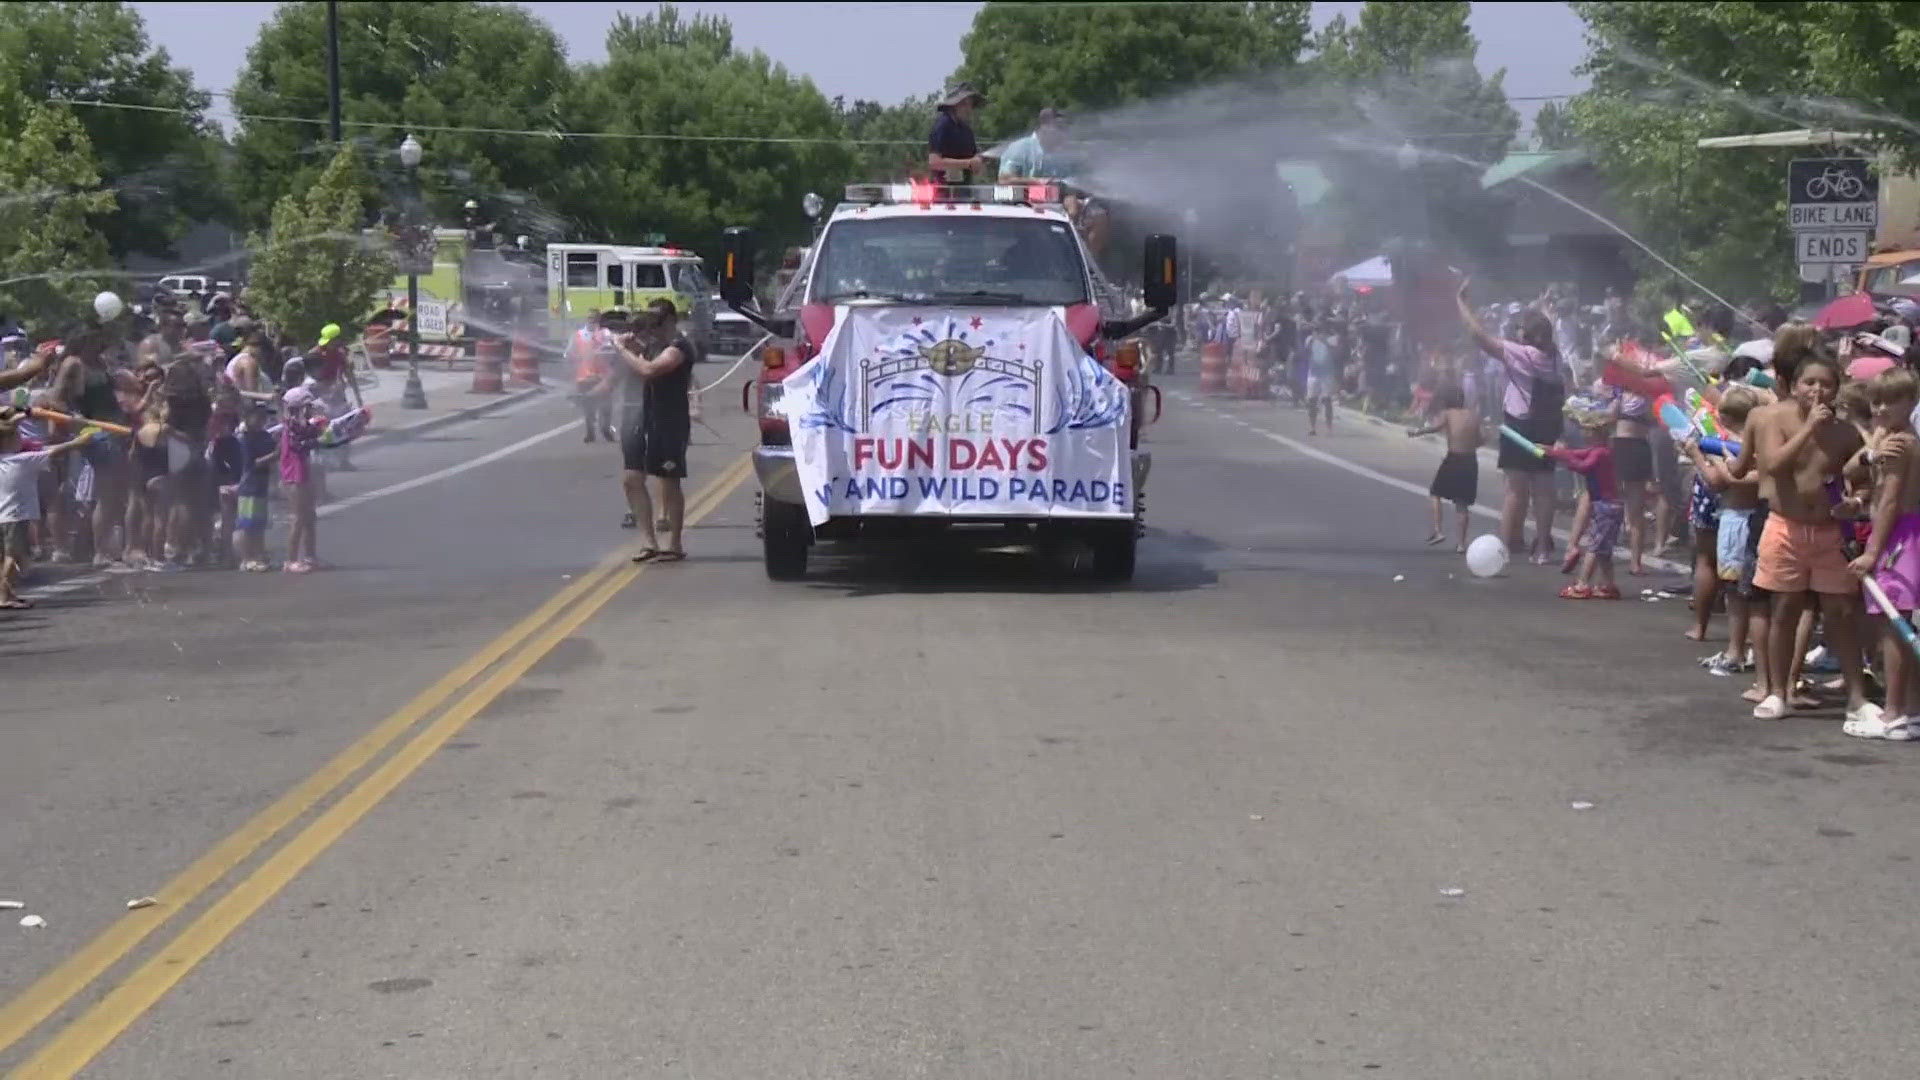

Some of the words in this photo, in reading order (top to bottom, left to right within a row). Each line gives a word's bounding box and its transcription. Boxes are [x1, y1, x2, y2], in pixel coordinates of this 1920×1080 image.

[1793, 207, 1825, 223] BIKE
[1834, 205, 1873, 222] LANE
[1807, 238, 1857, 257] ENDS
[418, 305, 440, 316] ROAD
[418, 319, 444, 330] LOSED
[909, 412, 994, 433] EAGLE
[854, 438, 934, 471] FUN
[949, 438, 1048, 472] DAYS
[845, 476, 909, 500] AND
[918, 476, 999, 500] WILD
[1009, 477, 1124, 506] PARADE
